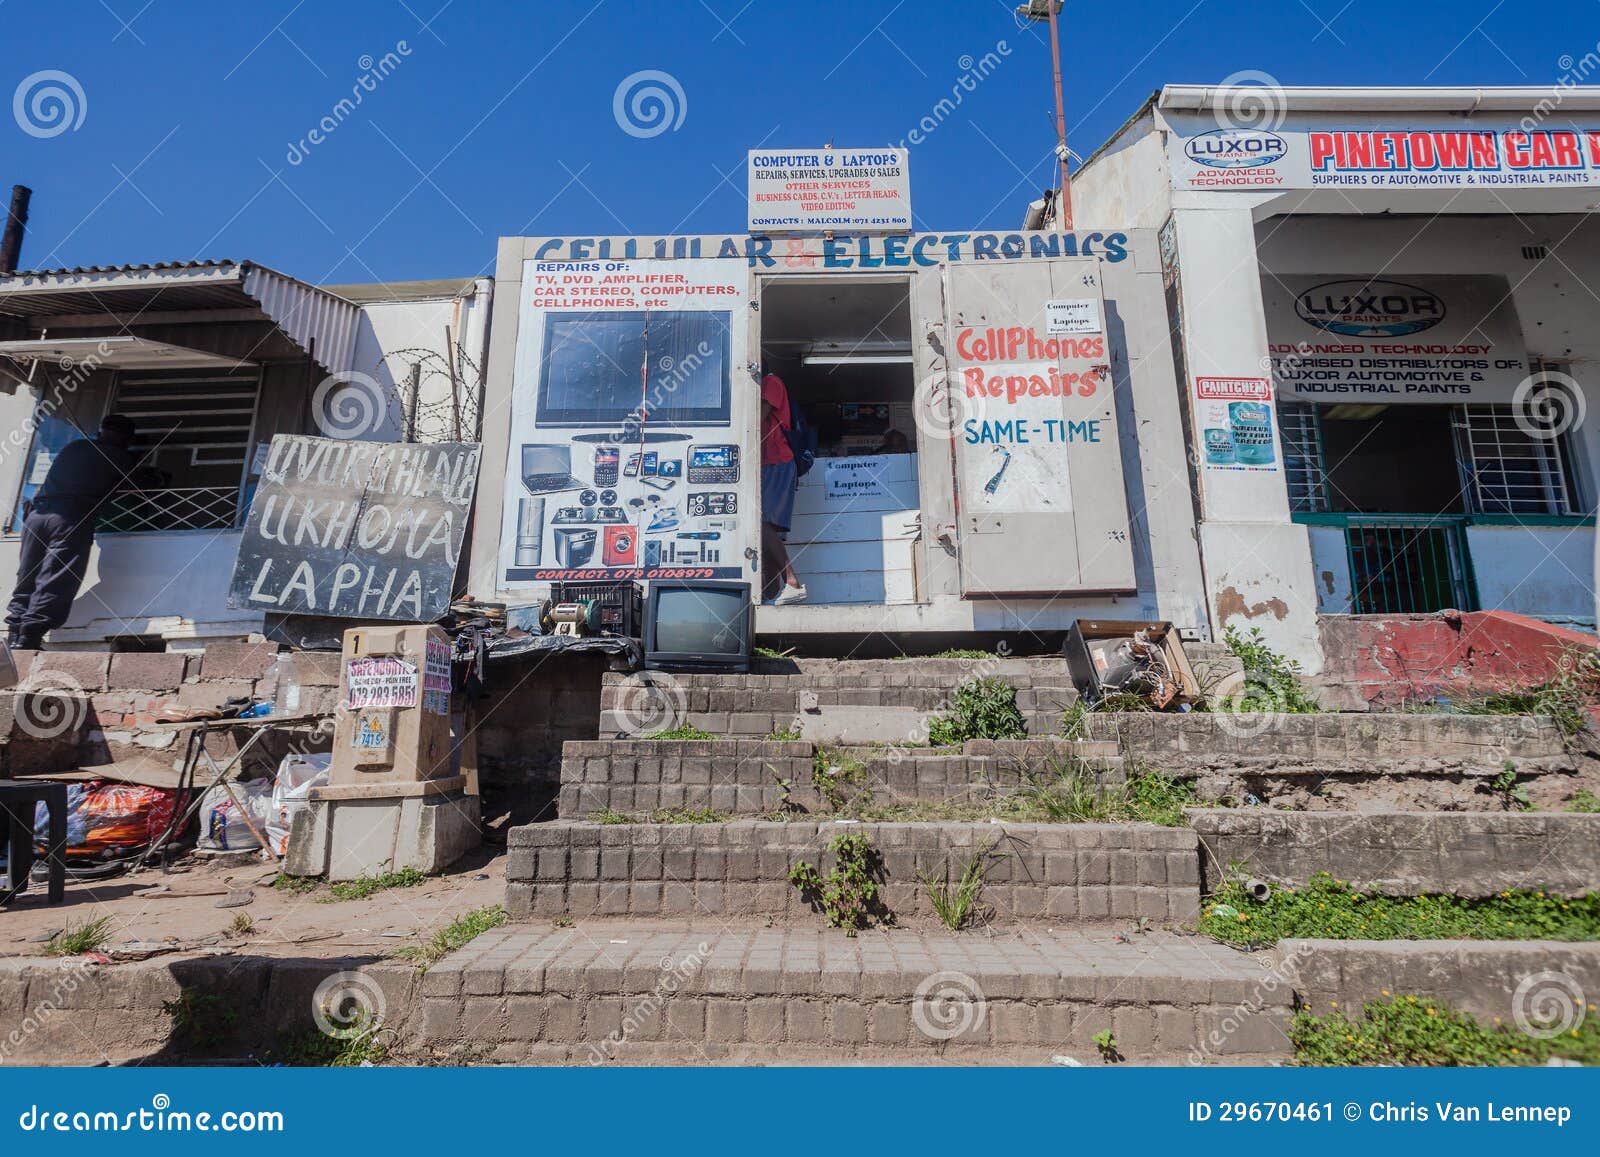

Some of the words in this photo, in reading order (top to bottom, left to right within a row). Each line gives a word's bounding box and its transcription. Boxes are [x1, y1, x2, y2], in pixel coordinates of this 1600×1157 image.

[1192, 139, 1282, 154] LUXOR
[1309, 131, 1500, 171] PINETOWN
[1502, 131, 1585, 170] CAR
[753, 155, 819, 167] COMPUTER
[824, 155, 834, 167] &
[843, 154, 897, 166] LAPTOPS
[755, 170, 789, 181] REPAIRS,
[790, 169, 828, 179] SERVICES,
[829, 168, 869, 178] UPGRADES
[870, 168, 876, 177] &
[877, 167, 900, 177] SALES
[1197, 169, 1276, 177] ADVANCED
[1188, 177, 1283, 186] TECHNOLOGY
[1312, 174, 1368, 184] SUPPLIERS
[1371, 174, 1385, 184] OF
[1388, 174, 1461, 184] AUTOMOTIVE
[1467, 174, 1476, 184] &
[1479, 174, 1544, 184] INDUSTRIAL
[1549, 173, 1589, 183] PAINTS
[786, 182, 819, 190] OTHER
[822, 181, 870, 189] SERVICES
[756, 193, 791, 202] BUSINESS
[844, 191, 872, 199] LETTER
[873, 190, 900, 199] HEADS,
[801, 203, 824, 211] VIDEO
[825, 202, 856, 210] EDITING
[807, 217, 850, 225] MALCOLM
[871, 218, 889, 226] 4231
[892, 217, 907, 225] 800
[784, 236, 816, 268] &
[823, 232, 1128, 269] ELECTRONICS
[536, 263, 600, 272] REPAIRS
[605, 263, 630, 272] OF:
[536, 275, 558, 286] TV,
[563, 275, 593, 284] DVD
[534, 287, 565, 296] CAR
[570, 286, 635, 297] STEREO,
[640, 285, 740, 297] COMPUTERS,
[533, 298, 639, 308] CELLPHONES,
[644, 298, 668, 307] etc
[1047, 303, 1090, 311] Computer
[1306, 295, 1439, 315] LUXOR
[1053, 318, 1089, 326] Laptops
[1342, 314, 1403, 323] PAINTS
[956, 326, 1105, 361] CellPhones
[1270, 344, 1365, 354] ADVANCED
[1370, 344, 1492, 354] TECHNOLOGY
[1359, 359, 1489, 369] DISTRIBUTORS
[1494, 359, 1523, 369] OF:
[1280, 371, 1340, 380] LUXOR
[1346, 371, 1465, 381] AUTOMOTIVE
[1470, 371, 1485, 381] &
[963, 367, 1100, 405] Repairs
[1202, 381, 1266, 393] PAINTCHEM
[1294, 383, 1400, 393] INDUSTRIAL
[1405, 384, 1471, 393] PAINTS
[964, 418, 1101, 444] SAME-TIME
[828, 461, 879, 470] Computer
[834, 480, 876, 490] Laptops
[535, 568, 610, 580] CONTACT:
[613, 568, 642, 580] 079
[353, 635, 360, 654] 1
[399, 676, 412, 684] FREE
